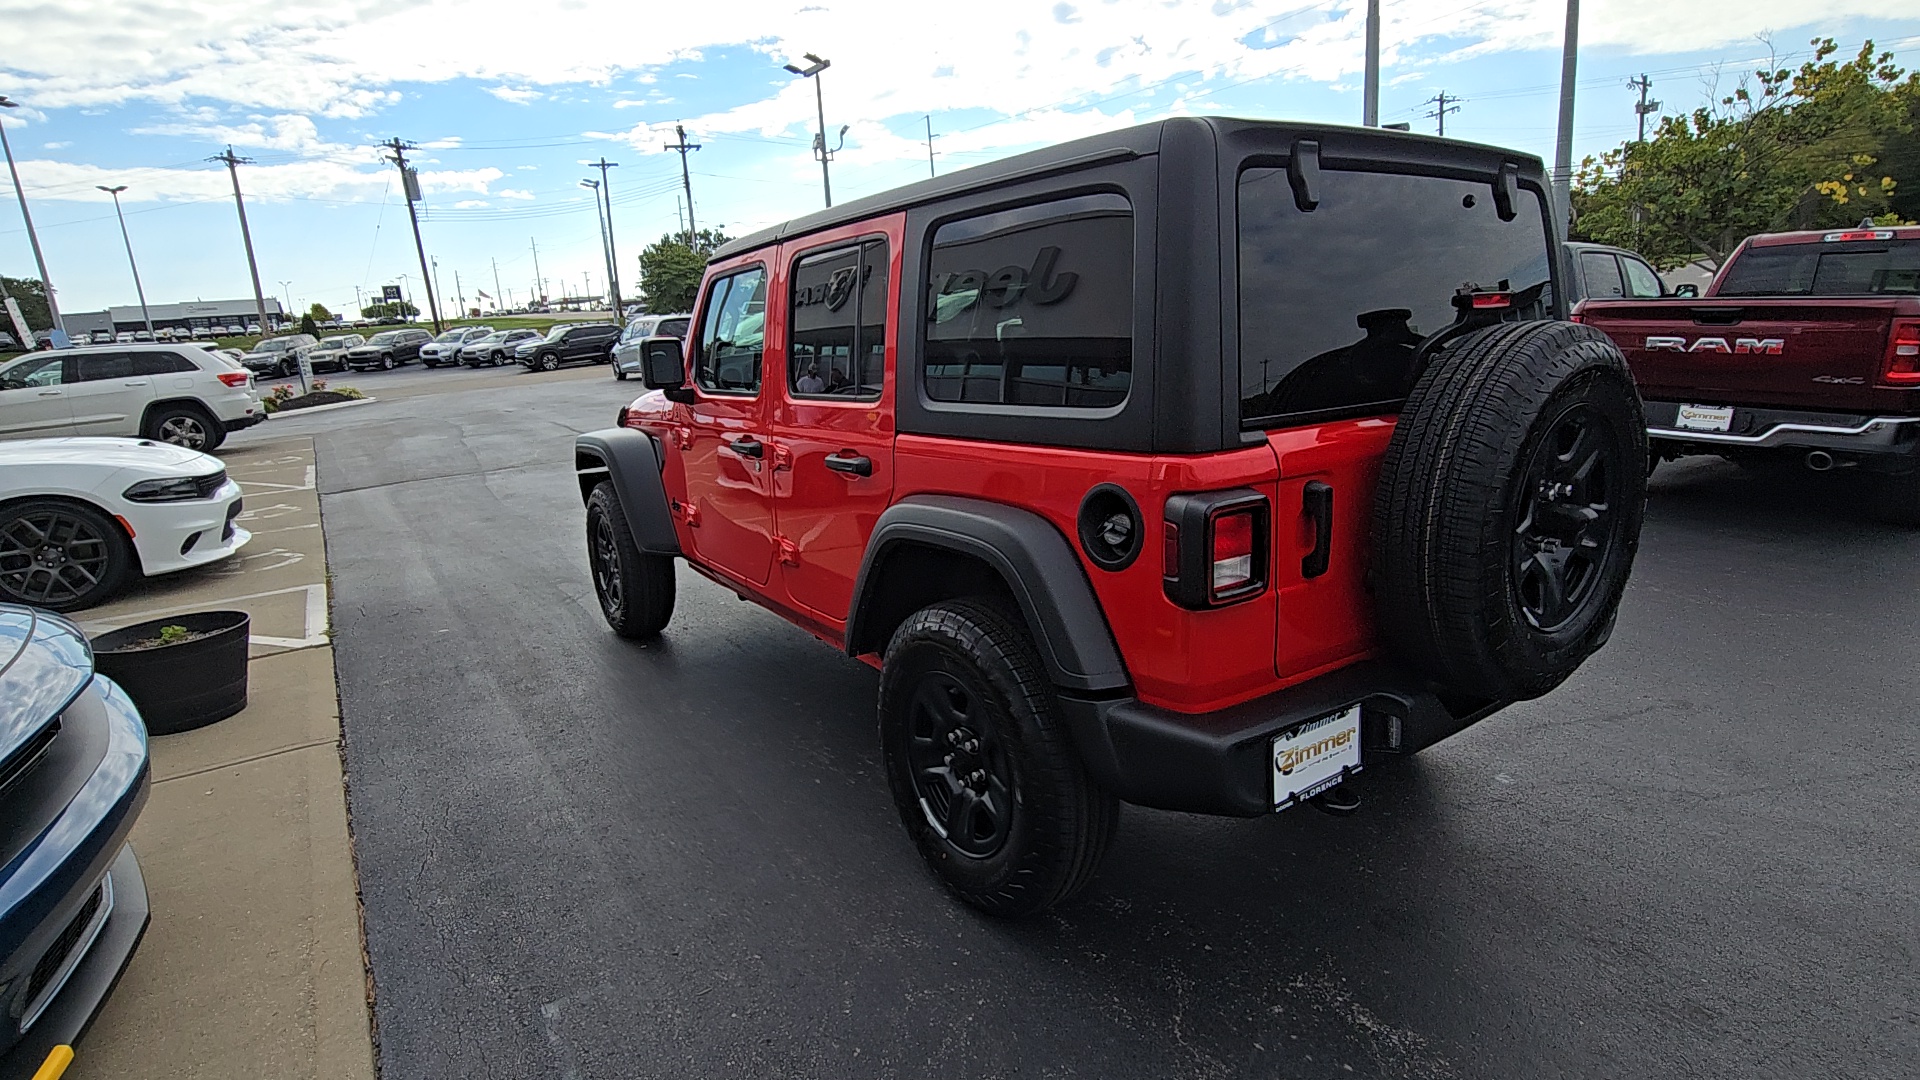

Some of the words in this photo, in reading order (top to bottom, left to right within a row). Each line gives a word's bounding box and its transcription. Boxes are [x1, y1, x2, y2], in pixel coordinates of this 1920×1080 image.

[1645, 336, 1785, 355] RAM
[1298, 711, 1341, 736] Zimmer
[1279, 726, 1356, 771] Zimmer
[1300, 775, 1343, 802] FLORENCE
